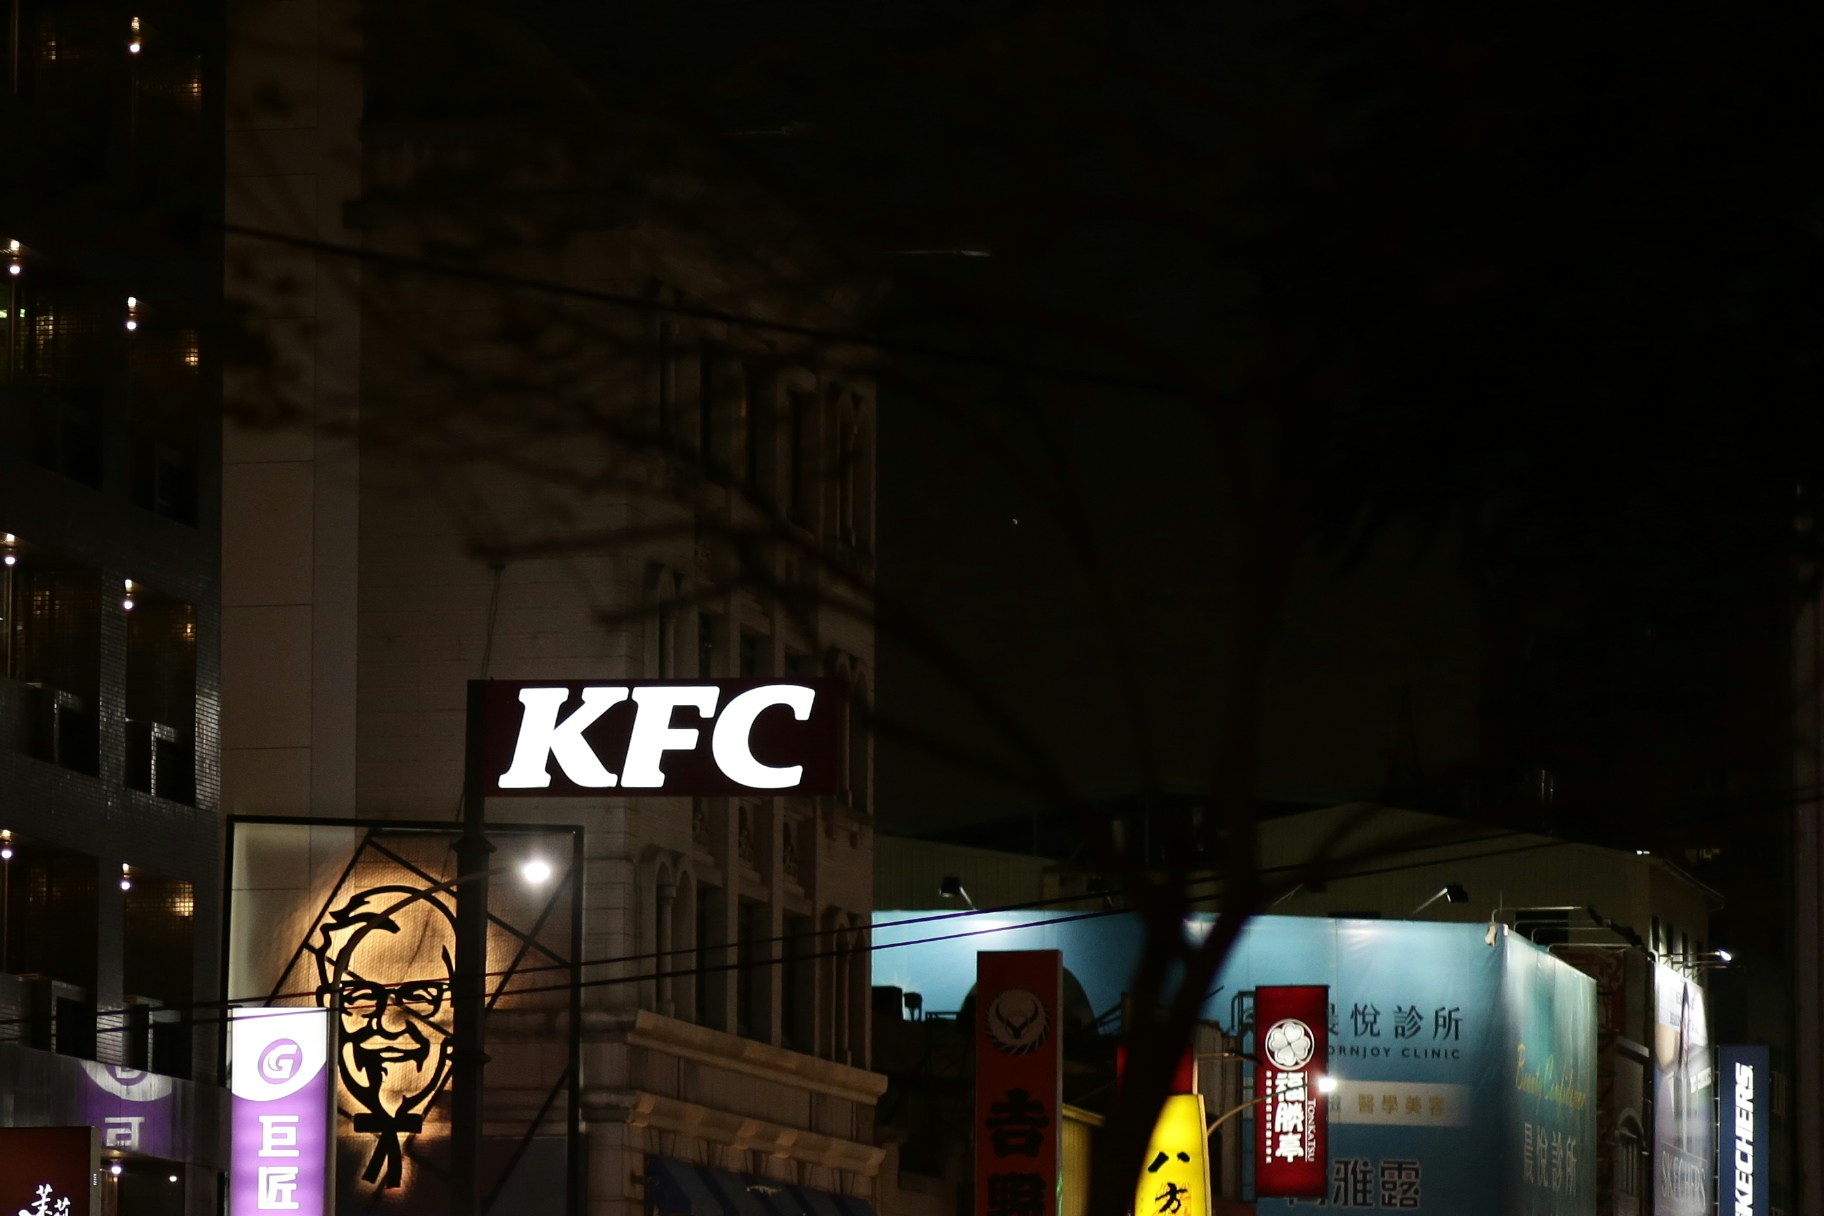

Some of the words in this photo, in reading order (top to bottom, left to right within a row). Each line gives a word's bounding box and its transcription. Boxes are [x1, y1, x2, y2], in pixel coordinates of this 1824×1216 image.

[496, 683, 816, 790] KFC
[1328, 1044, 1392, 1060] ORNJOY
[1402, 1049, 1461, 1060] CLINIC
